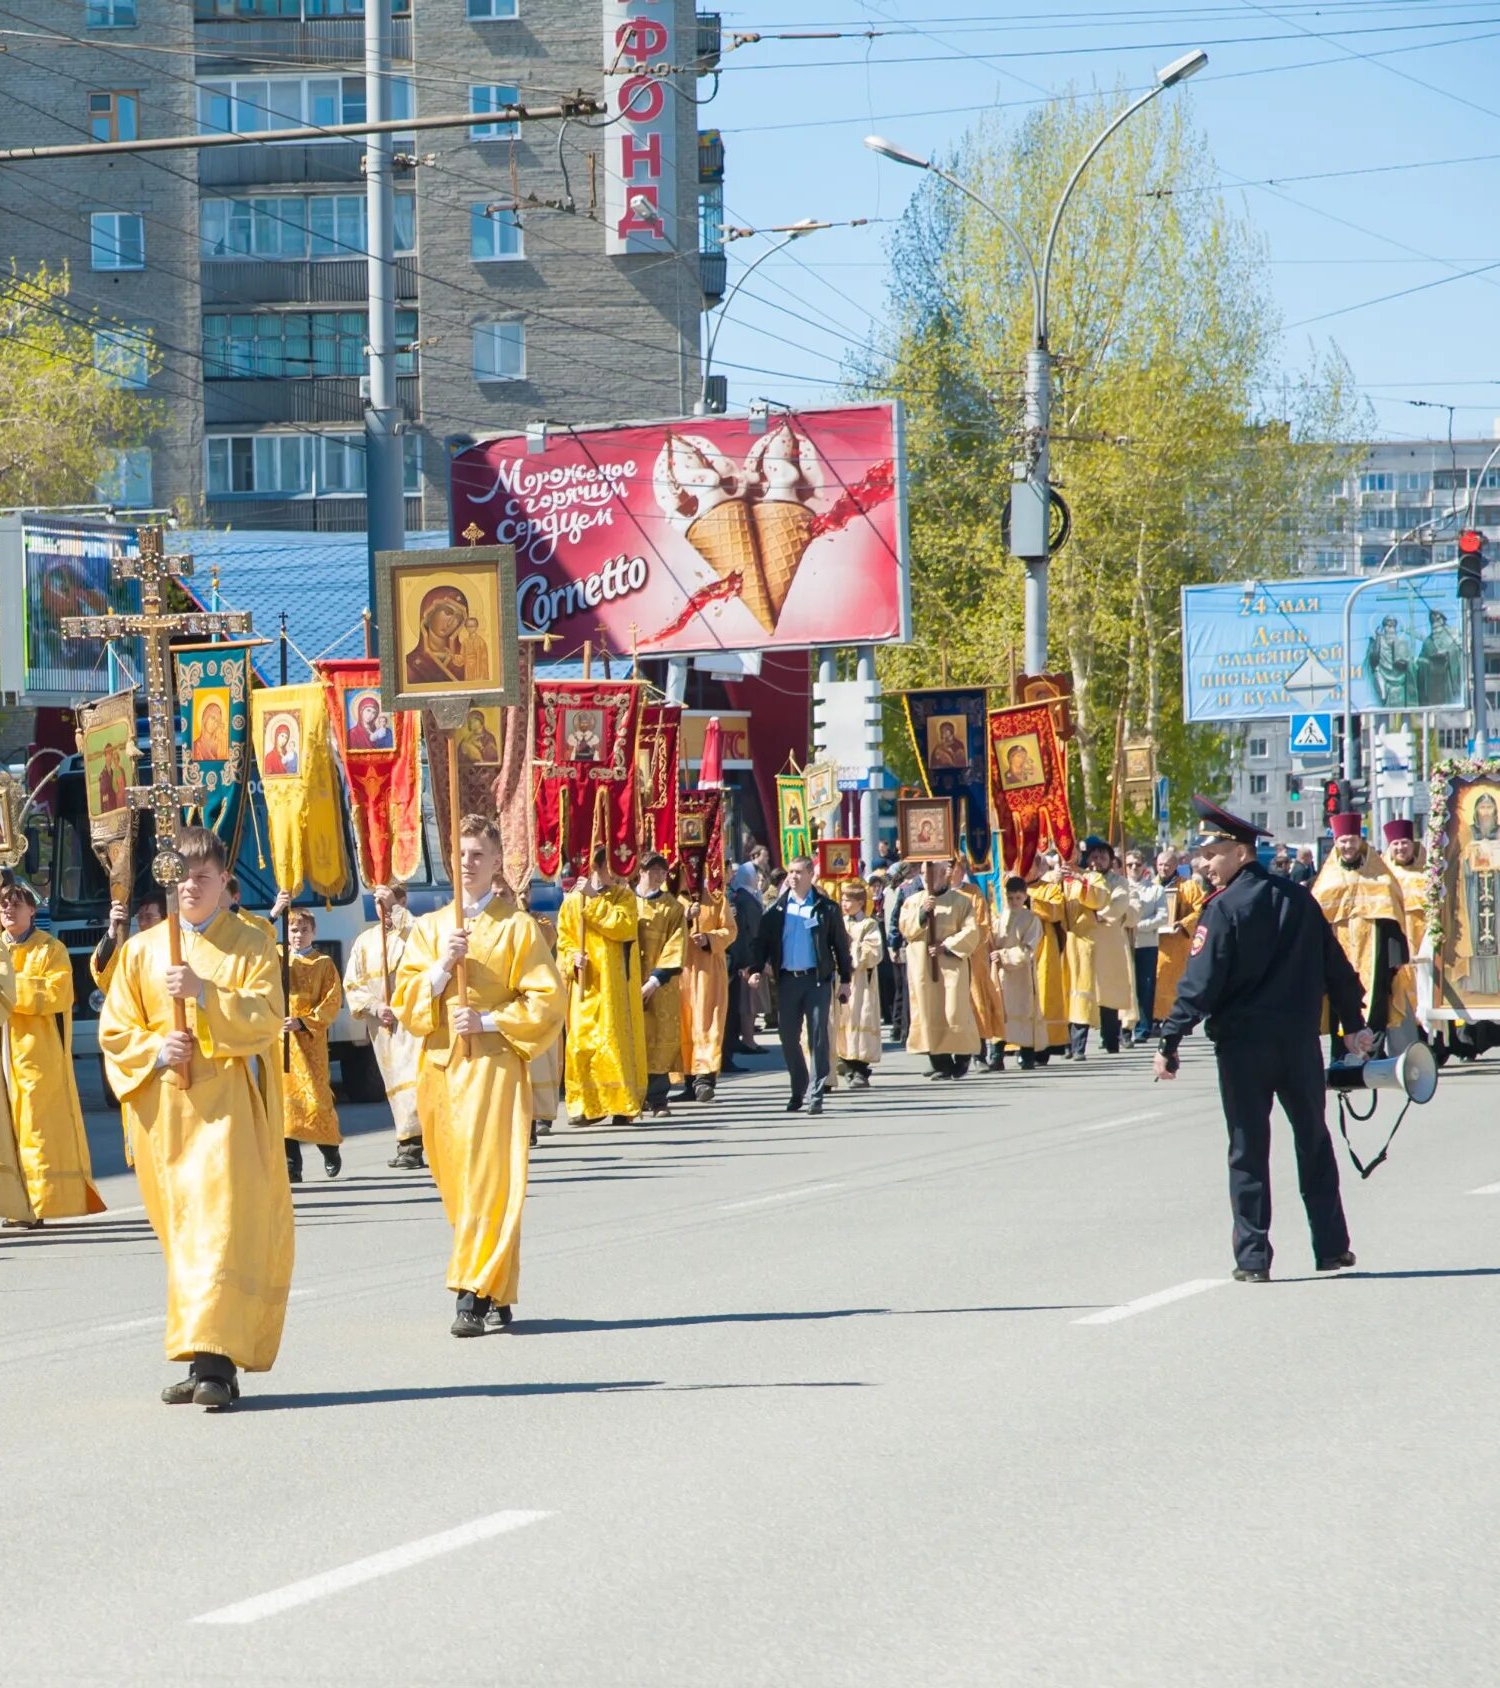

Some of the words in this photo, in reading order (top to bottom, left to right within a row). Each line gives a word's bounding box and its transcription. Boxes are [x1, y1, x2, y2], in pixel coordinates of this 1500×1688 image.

[615, 0, 668, 240] ФОНД
[467, 458, 638, 503] Мороженое
[525, 481, 629, 514] горячим
[516, 555, 648, 636] Cornetto
[1239, 597, 1267, 616] 24
